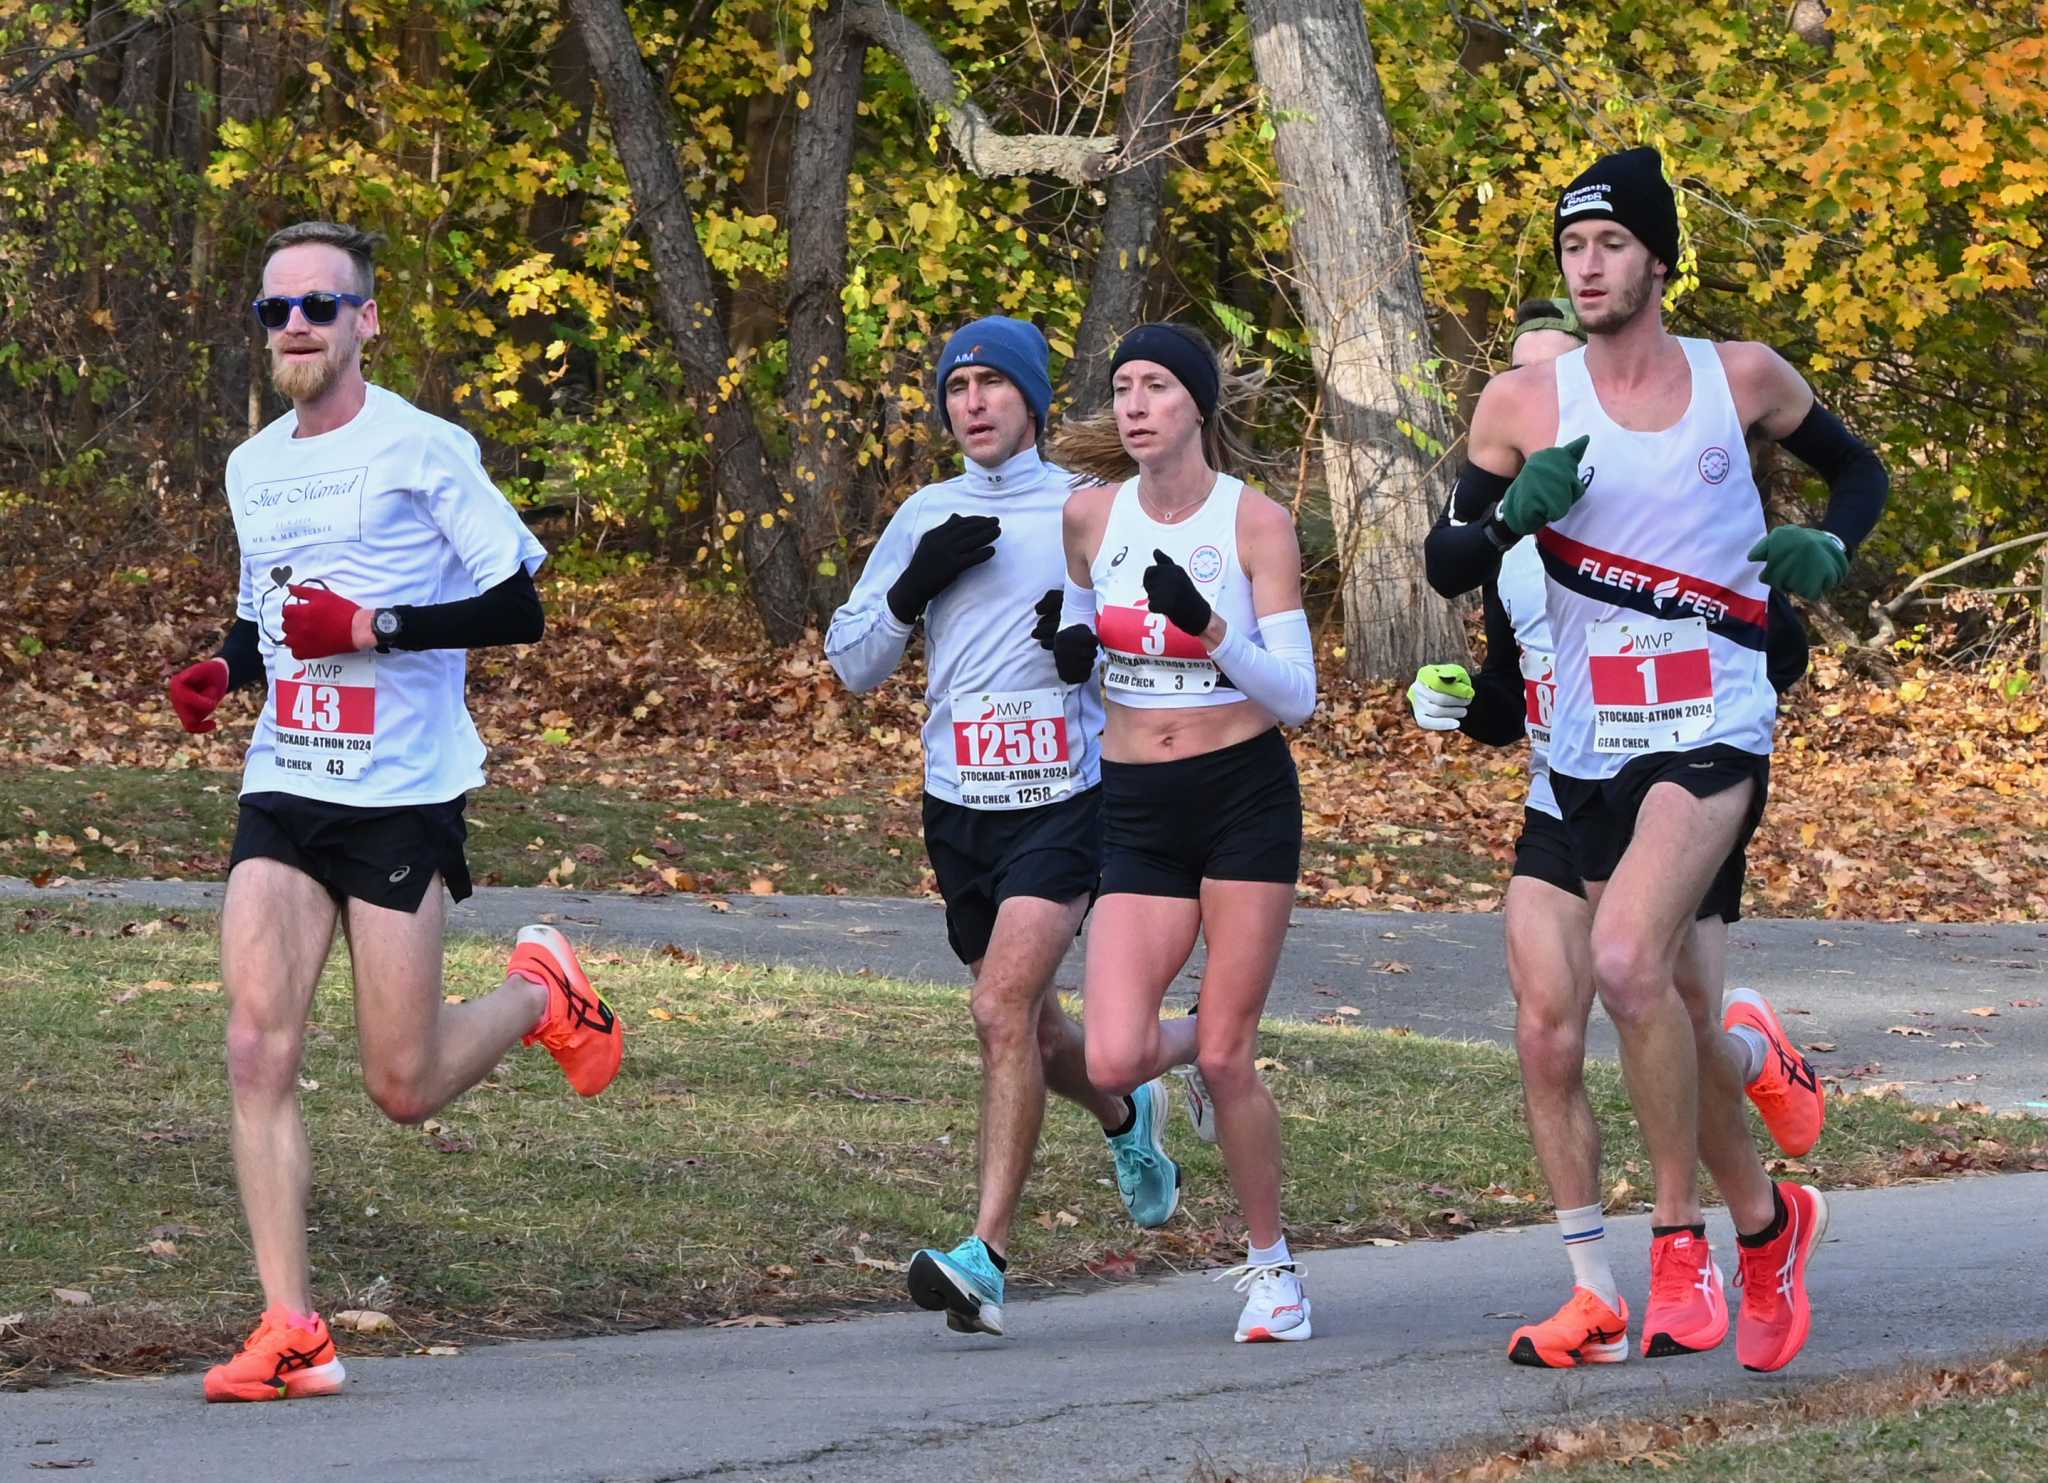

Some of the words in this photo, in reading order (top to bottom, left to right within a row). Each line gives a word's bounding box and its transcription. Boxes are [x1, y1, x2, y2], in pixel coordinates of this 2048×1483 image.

[245, 487, 283, 516] Just
[287, 474, 359, 503] Married
[1577, 557, 1652, 593] FLEET
[1678, 590, 1729, 622] FEET
[1142, 612, 1167, 656] 3
[1635, 632, 1673, 650] MVP
[307, 663, 343, 680] MVP
[1108, 672, 1130, 685] GEAR
[1130, 677, 1156, 688] CHECK
[1174, 674, 1184, 690] 3
[1636, 657, 1659, 705] 1
[292, 684, 341, 732] 43
[996, 700, 1033, 717] MVP
[1598, 707, 1683, 724] STOCKADE-ATHON
[1685, 703, 1713, 718] 2024
[346, 738, 372, 751] 2024
[962, 720, 1058, 765] 1258
[1598, 737, 1621, 749] GEAR
[1622, 737, 1650, 749] CHECK
[1672, 731, 1680, 743] 1
[286, 758, 313, 771] CHECK
[326, 759, 344, 776] 43
[960, 768, 1041, 783] STOCKADE-ATHON
[1042, 766, 1068, 779] 2024
[962, 794, 981, 804] GEAR
[982, 794, 1011, 804] CHECK
[1016, 786, 1052, 804] 1258
